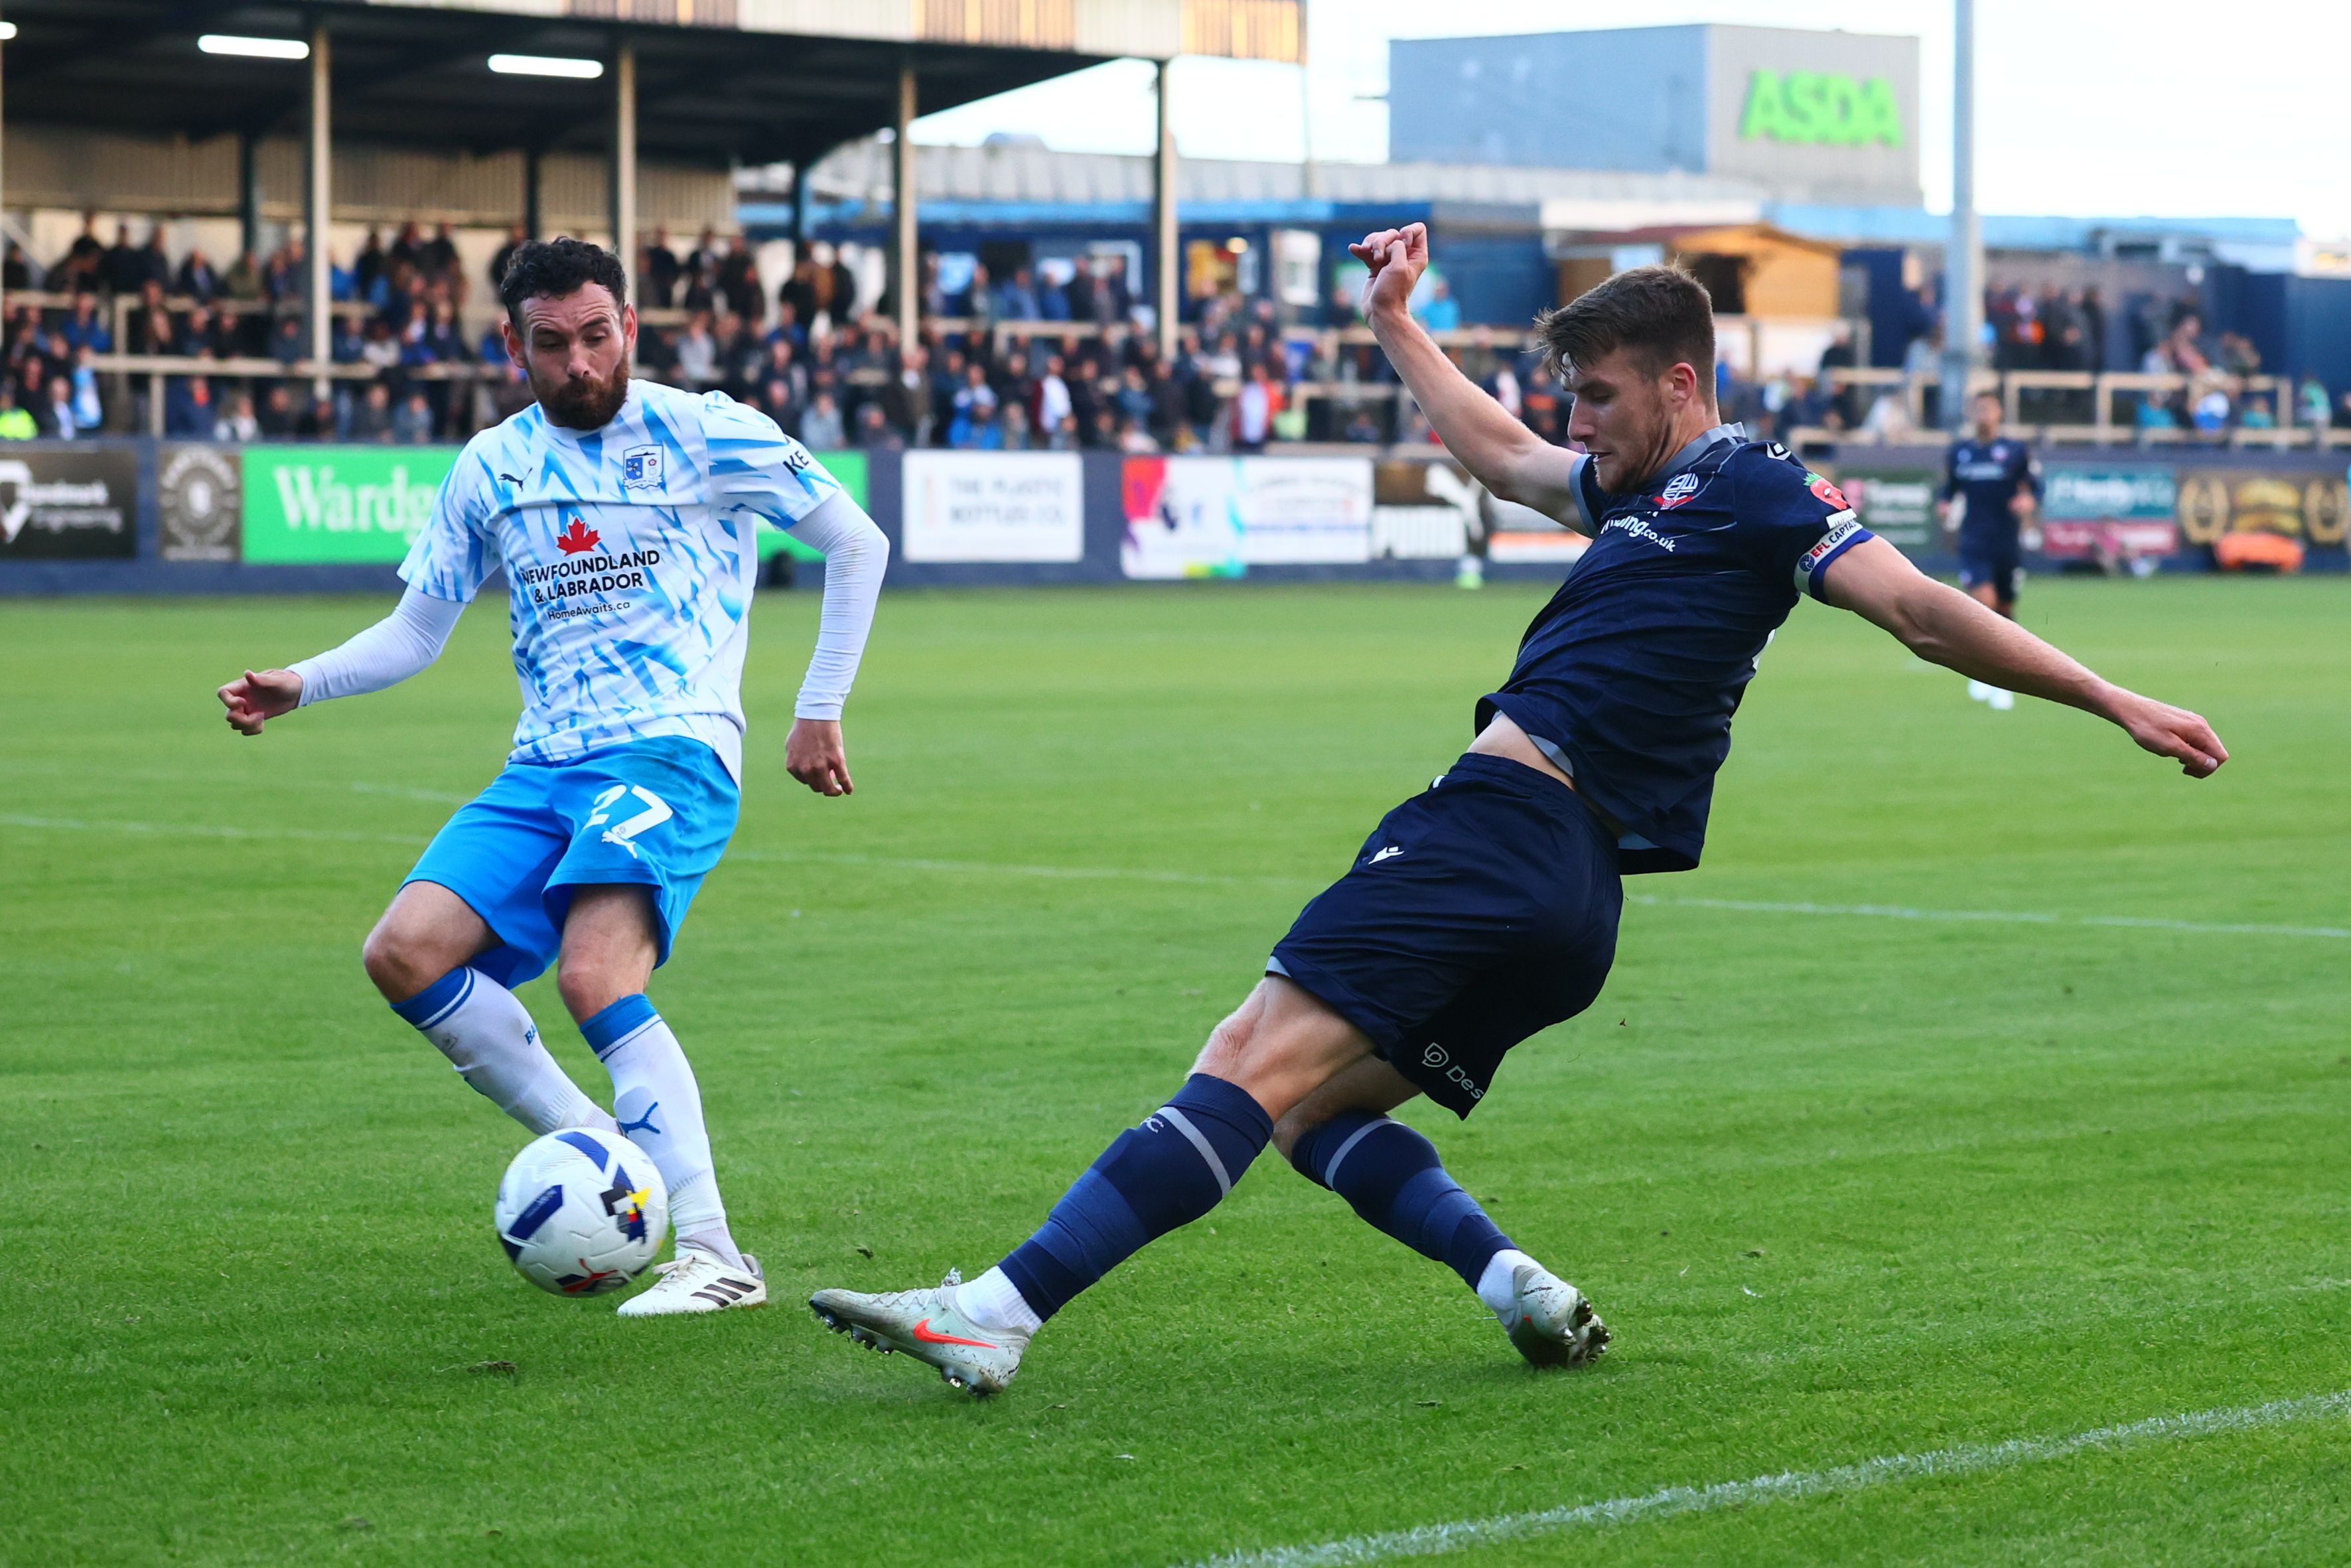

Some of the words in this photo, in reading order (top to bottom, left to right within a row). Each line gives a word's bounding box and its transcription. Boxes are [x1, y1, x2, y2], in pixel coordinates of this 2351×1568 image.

[1740, 70, 1902, 146] ASDA
[1810, 542, 1831, 558] EFL
[521, 549, 660, 586] NEWFOUNDLAND
[534, 588, 543, 603] &
[547, 572, 644, 601] LABRADOR
[547, 601, 630, 621] HomeAwaits.ca
[583, 784, 674, 840] 27
